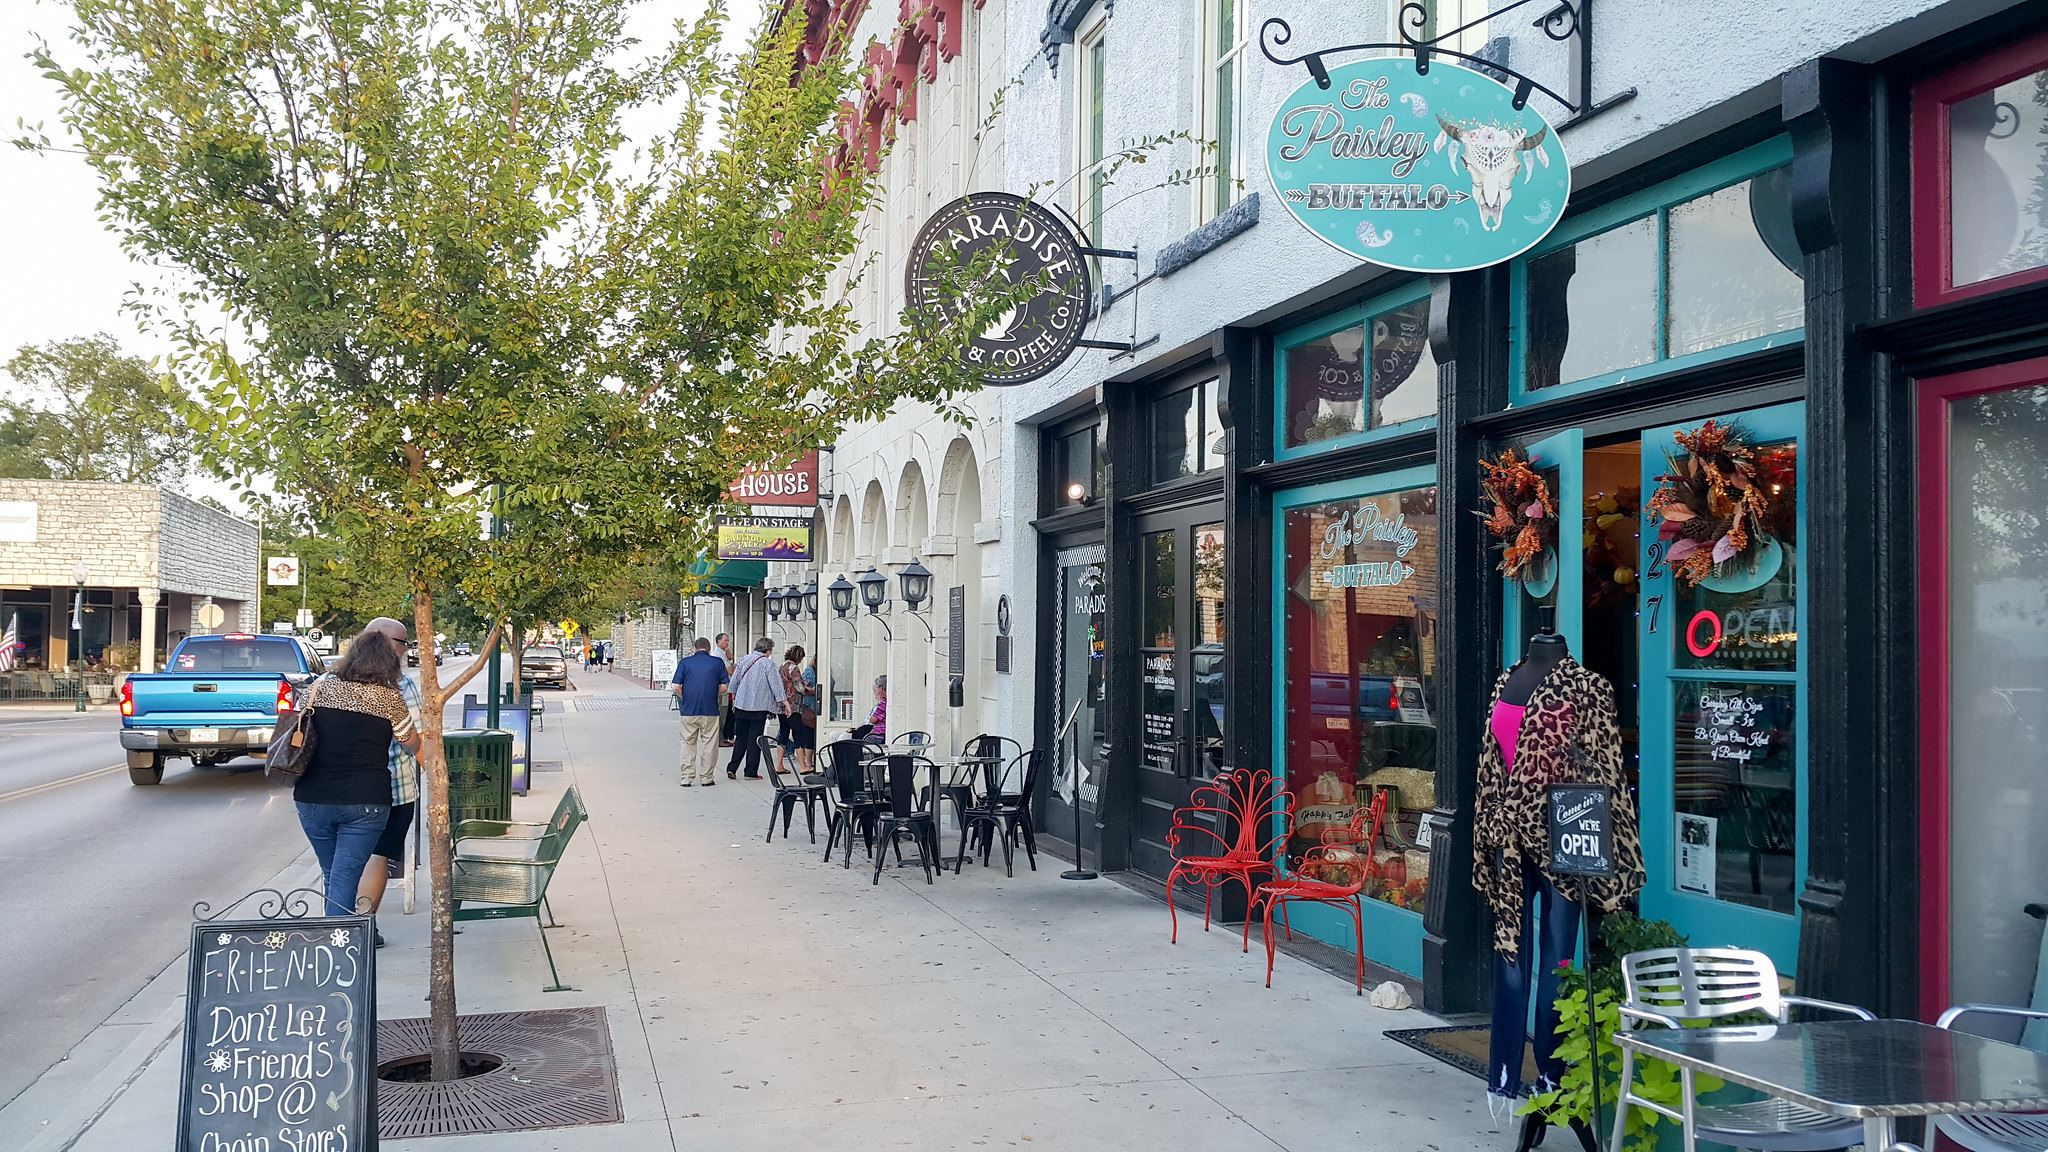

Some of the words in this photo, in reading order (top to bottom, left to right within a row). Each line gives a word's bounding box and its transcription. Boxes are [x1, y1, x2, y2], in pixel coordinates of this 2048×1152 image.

[1340, 76, 1389, 110] The
[1279, 103, 1429, 178] Paisley
[1307, 183, 1450, 211] BUFFALO
[929, 211, 1072, 280] PARADISE
[968, 345, 986, 364] &
[991, 329, 1058, 367] COFFEE
[730, 471, 810, 497] HOUSE
[726, 517, 750, 527] LIVE
[753, 517, 767, 528] ON
[771, 518, 804, 528] STAGE
[1321, 510, 1352, 559] The
[1352, 503, 1418, 557] Paisley
[1077, 566, 1102, 588] Welcome
[1332, 561, 1403, 588] BUFFALO
[1075, 594, 1105, 614] PARADIS
[1686, 606, 1795, 657] OPEN
[1146, 657, 1171, 670] PARADISE
[222, 701, 274, 709] TUNDRA
[1729, 697, 1743, 710] All
[1743, 697, 1764, 714] Sizes
[1711, 712, 1735, 726] Small
[1695, 728, 1708, 740] Be
[1709, 728, 1729, 746] Your
[1747, 732, 1770, 747] Kind
[1719, 746, 1752, 764] Beautiful
[449, 791, 498, 805] ANBURY
[1301, 809, 1332, 822] Happy
[1335, 806, 1354, 821] Fall
[1557, 803, 1583, 823] Come
[1578, 818, 1601, 832] WE'RE
[1560, 833, 1600, 857] OPEN
[206, 1004, 278, 1047] Don't
[285, 1003, 326, 1037] Let
[199, 1081, 274, 1118] Shop
[277, 1080, 317, 1124] @
[201, 1131, 270, 1152] Chain
